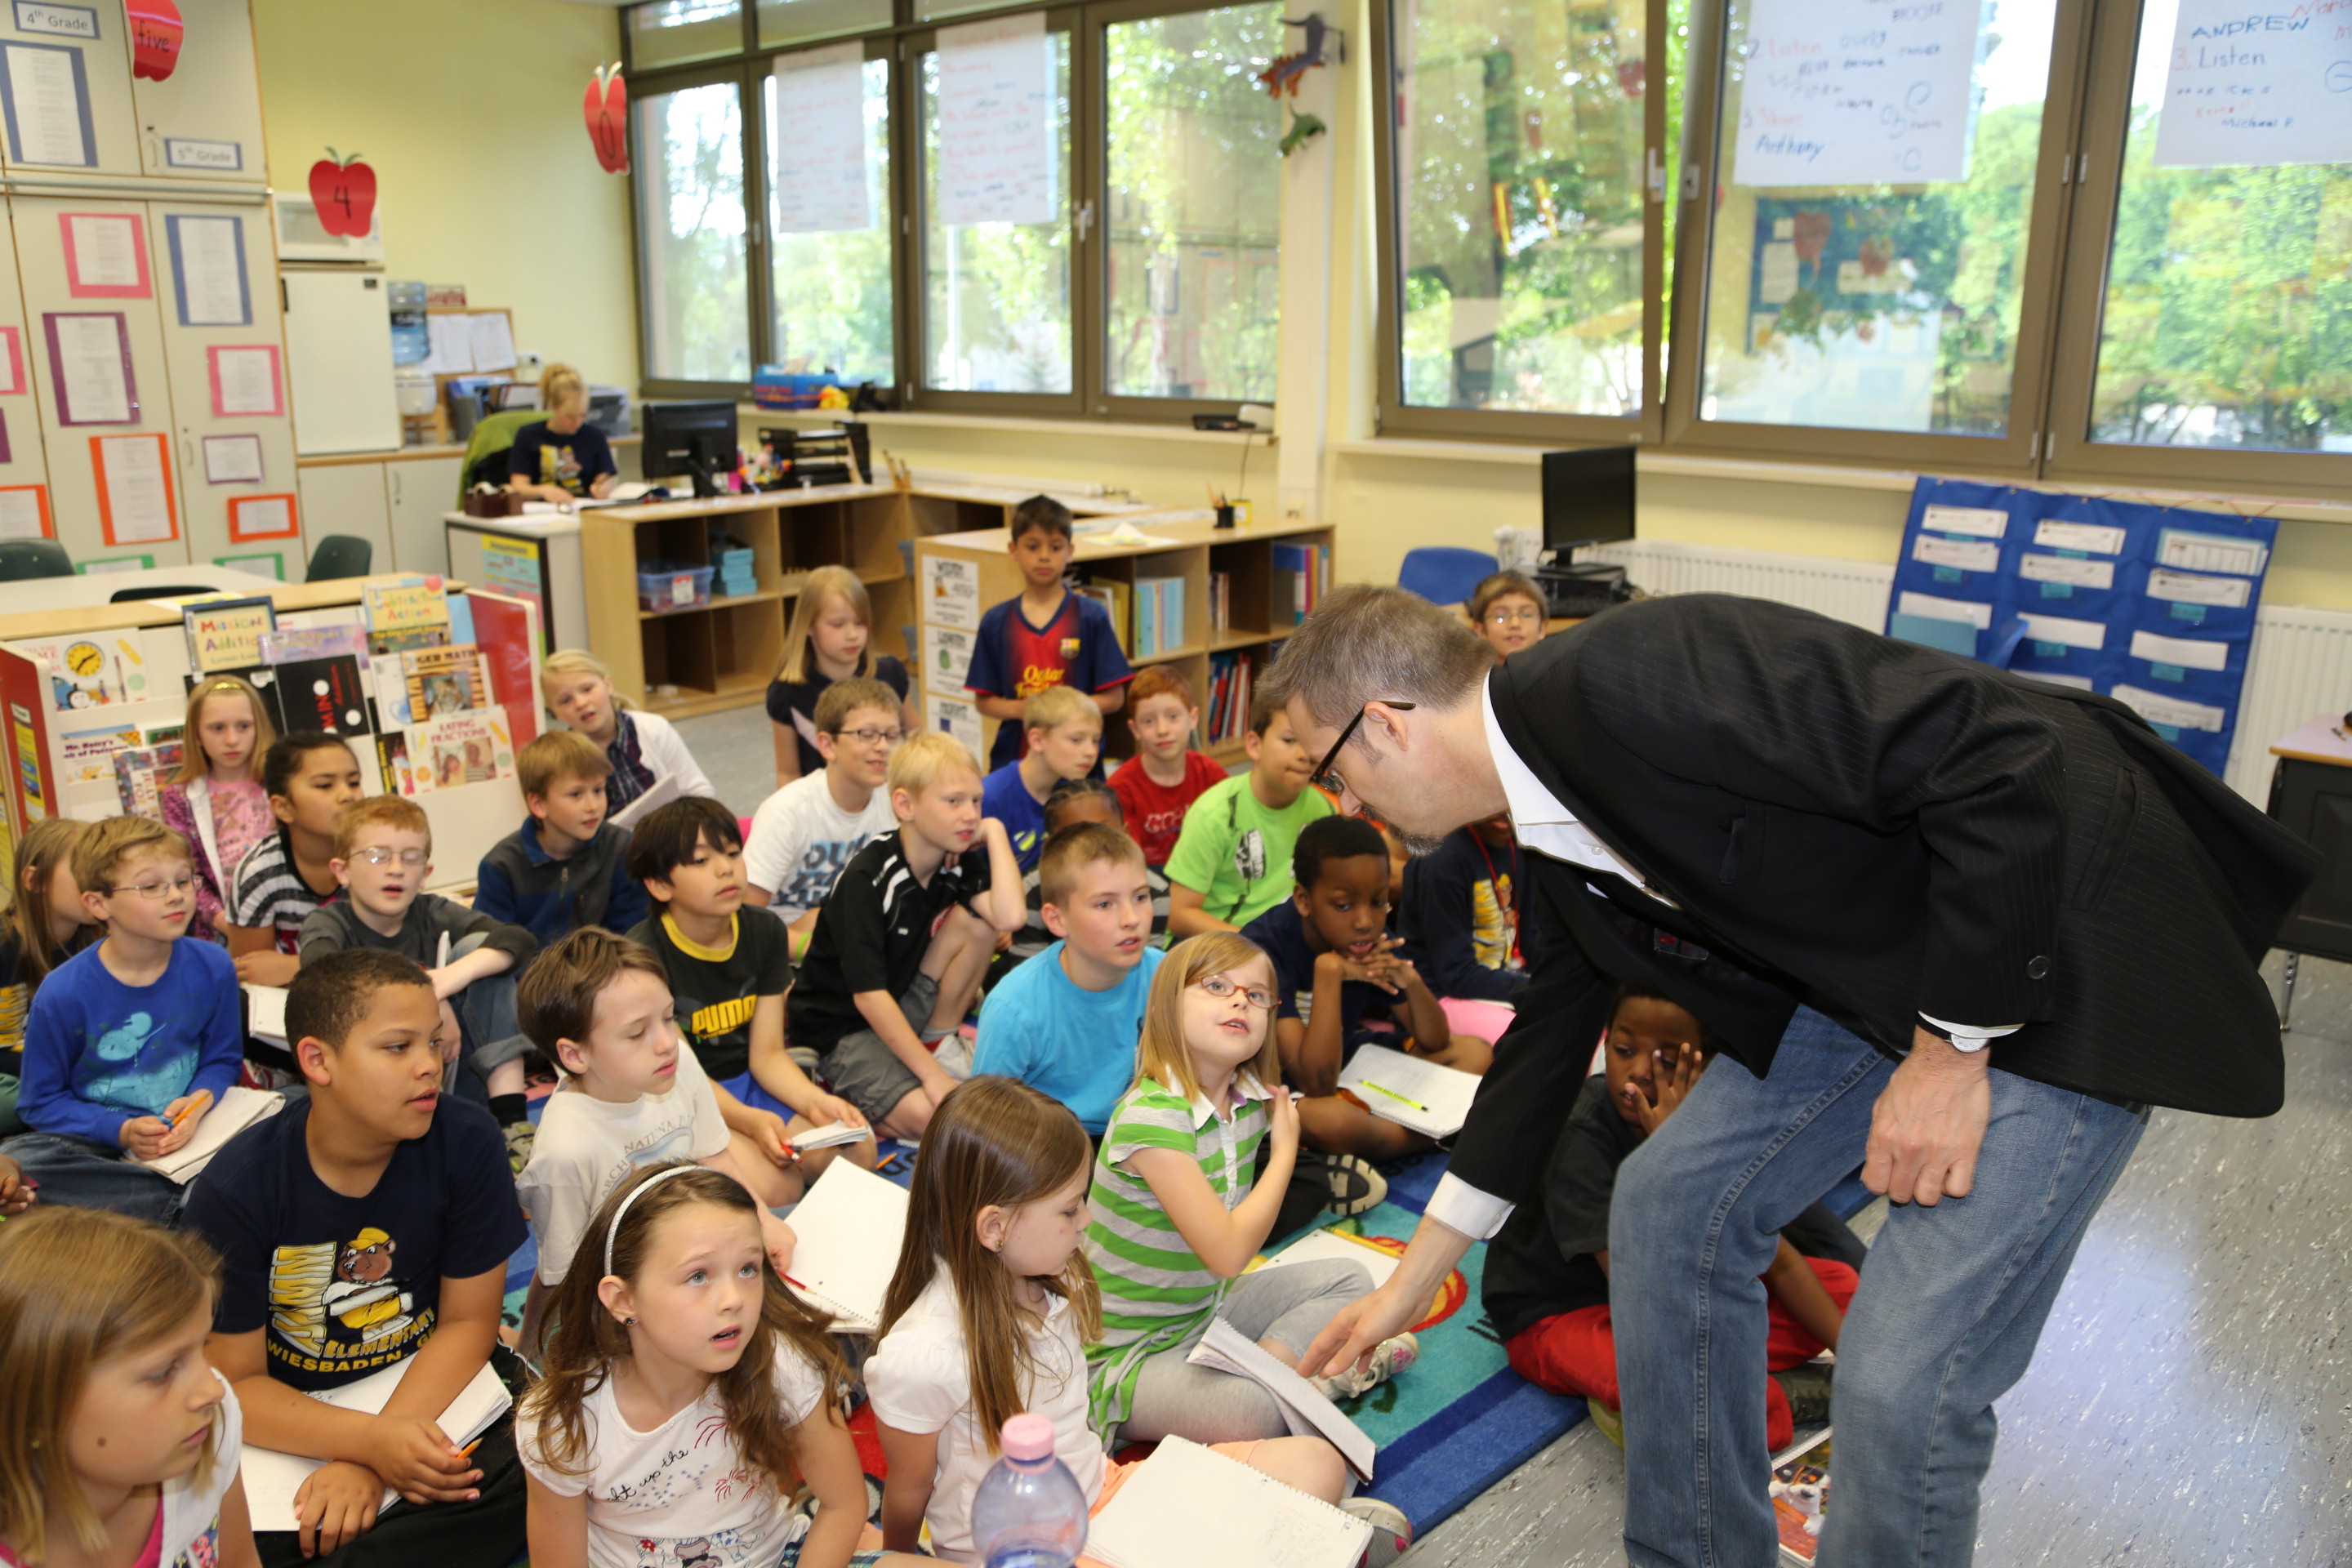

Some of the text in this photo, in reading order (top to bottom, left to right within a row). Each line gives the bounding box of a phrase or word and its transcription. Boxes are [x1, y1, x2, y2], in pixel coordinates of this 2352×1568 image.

[26, 9, 87, 30] 4th Grade
[2191, 15, 2310, 39] ANDREW
[138, 20, 170, 53] five
[2198, 44, 2267, 69] Listen
[196, 149, 231, 163] Grade
[333, 185, 354, 220] 4
[1023, 665, 1066, 686] Qatar
[431, 728, 487, 742] FRACTIONS
[439, 719, 474, 732] EATING
[691, 994, 758, 1035] PUMA
[323, 1306, 434, 1359] ELEMENTARY
[639, 1450, 688, 1487] up the
